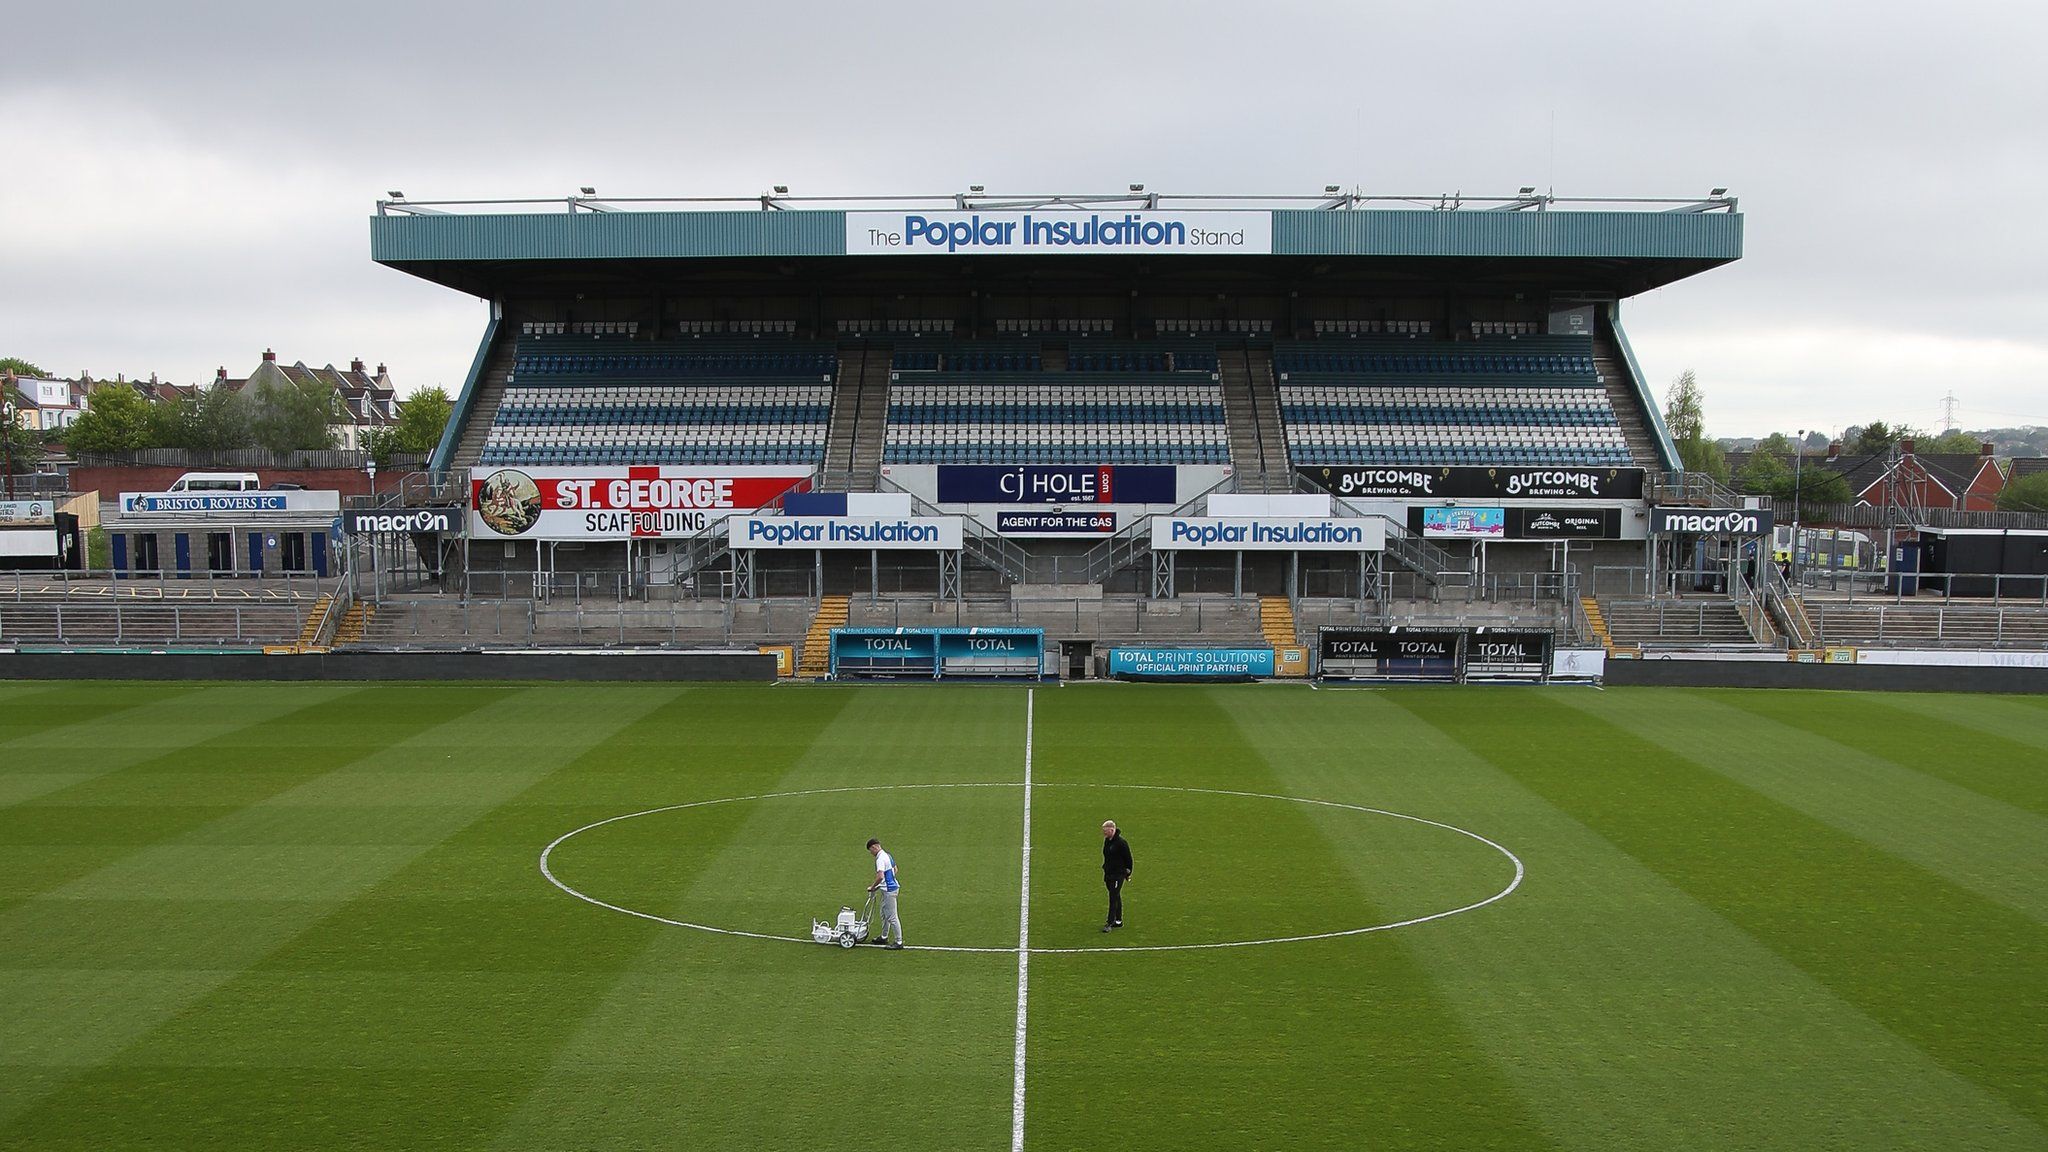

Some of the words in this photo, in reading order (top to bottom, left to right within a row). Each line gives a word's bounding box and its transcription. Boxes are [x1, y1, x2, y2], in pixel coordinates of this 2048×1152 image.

[868, 228, 901, 246] The
[905, 215, 1016, 253] Poplar
[1023, 214, 1185, 246] Insulation
[1191, 228, 1244, 246] Stand
[1033, 474, 1095, 493] HOLE
[1339, 470, 1433, 494] BUTCOMBE
[1506, 471, 1599, 495] BUTCOMBE
[556, 479, 601, 508] ST.
[608, 479, 735, 508] GEORGE
[156, 498, 206, 510] BRISTOL
[209, 497, 257, 509] ROVERS
[261, 497, 277, 509] FC
[356, 511, 449, 532] macron
[585, 511, 706, 533] SCAFFOLDING
[1001, 517, 1039, 527] AGENT
[1041, 517, 1063, 527] FOR
[1065, 517, 1087, 527] THE
[1089, 517, 1112, 527] GAS
[1665, 512, 1758, 533] macron
[749, 520, 824, 545] Poplar
[829, 520, 939, 541] Insulation
[1172, 521, 1248, 546] Poplar
[1252, 521, 1362, 543] Insulation
[864, 638, 912, 650] TOTAL
[968, 638, 1015, 650] TOTAL
[1331, 641, 1378, 653] TOTAL
[1399, 642, 1446, 653] TOTAL
[1478, 643, 1526, 656] TOTAL
[1118, 652, 1154, 662] TOTAL
[1157, 652, 1193, 662] PRINT
[1196, 652, 1267, 663] SOLUTIONS
[1136, 663, 1176, 672] OFFICIAL
[1178, 663, 1204, 672] PRINT
[1207, 664, 1249, 673] PARTNER
